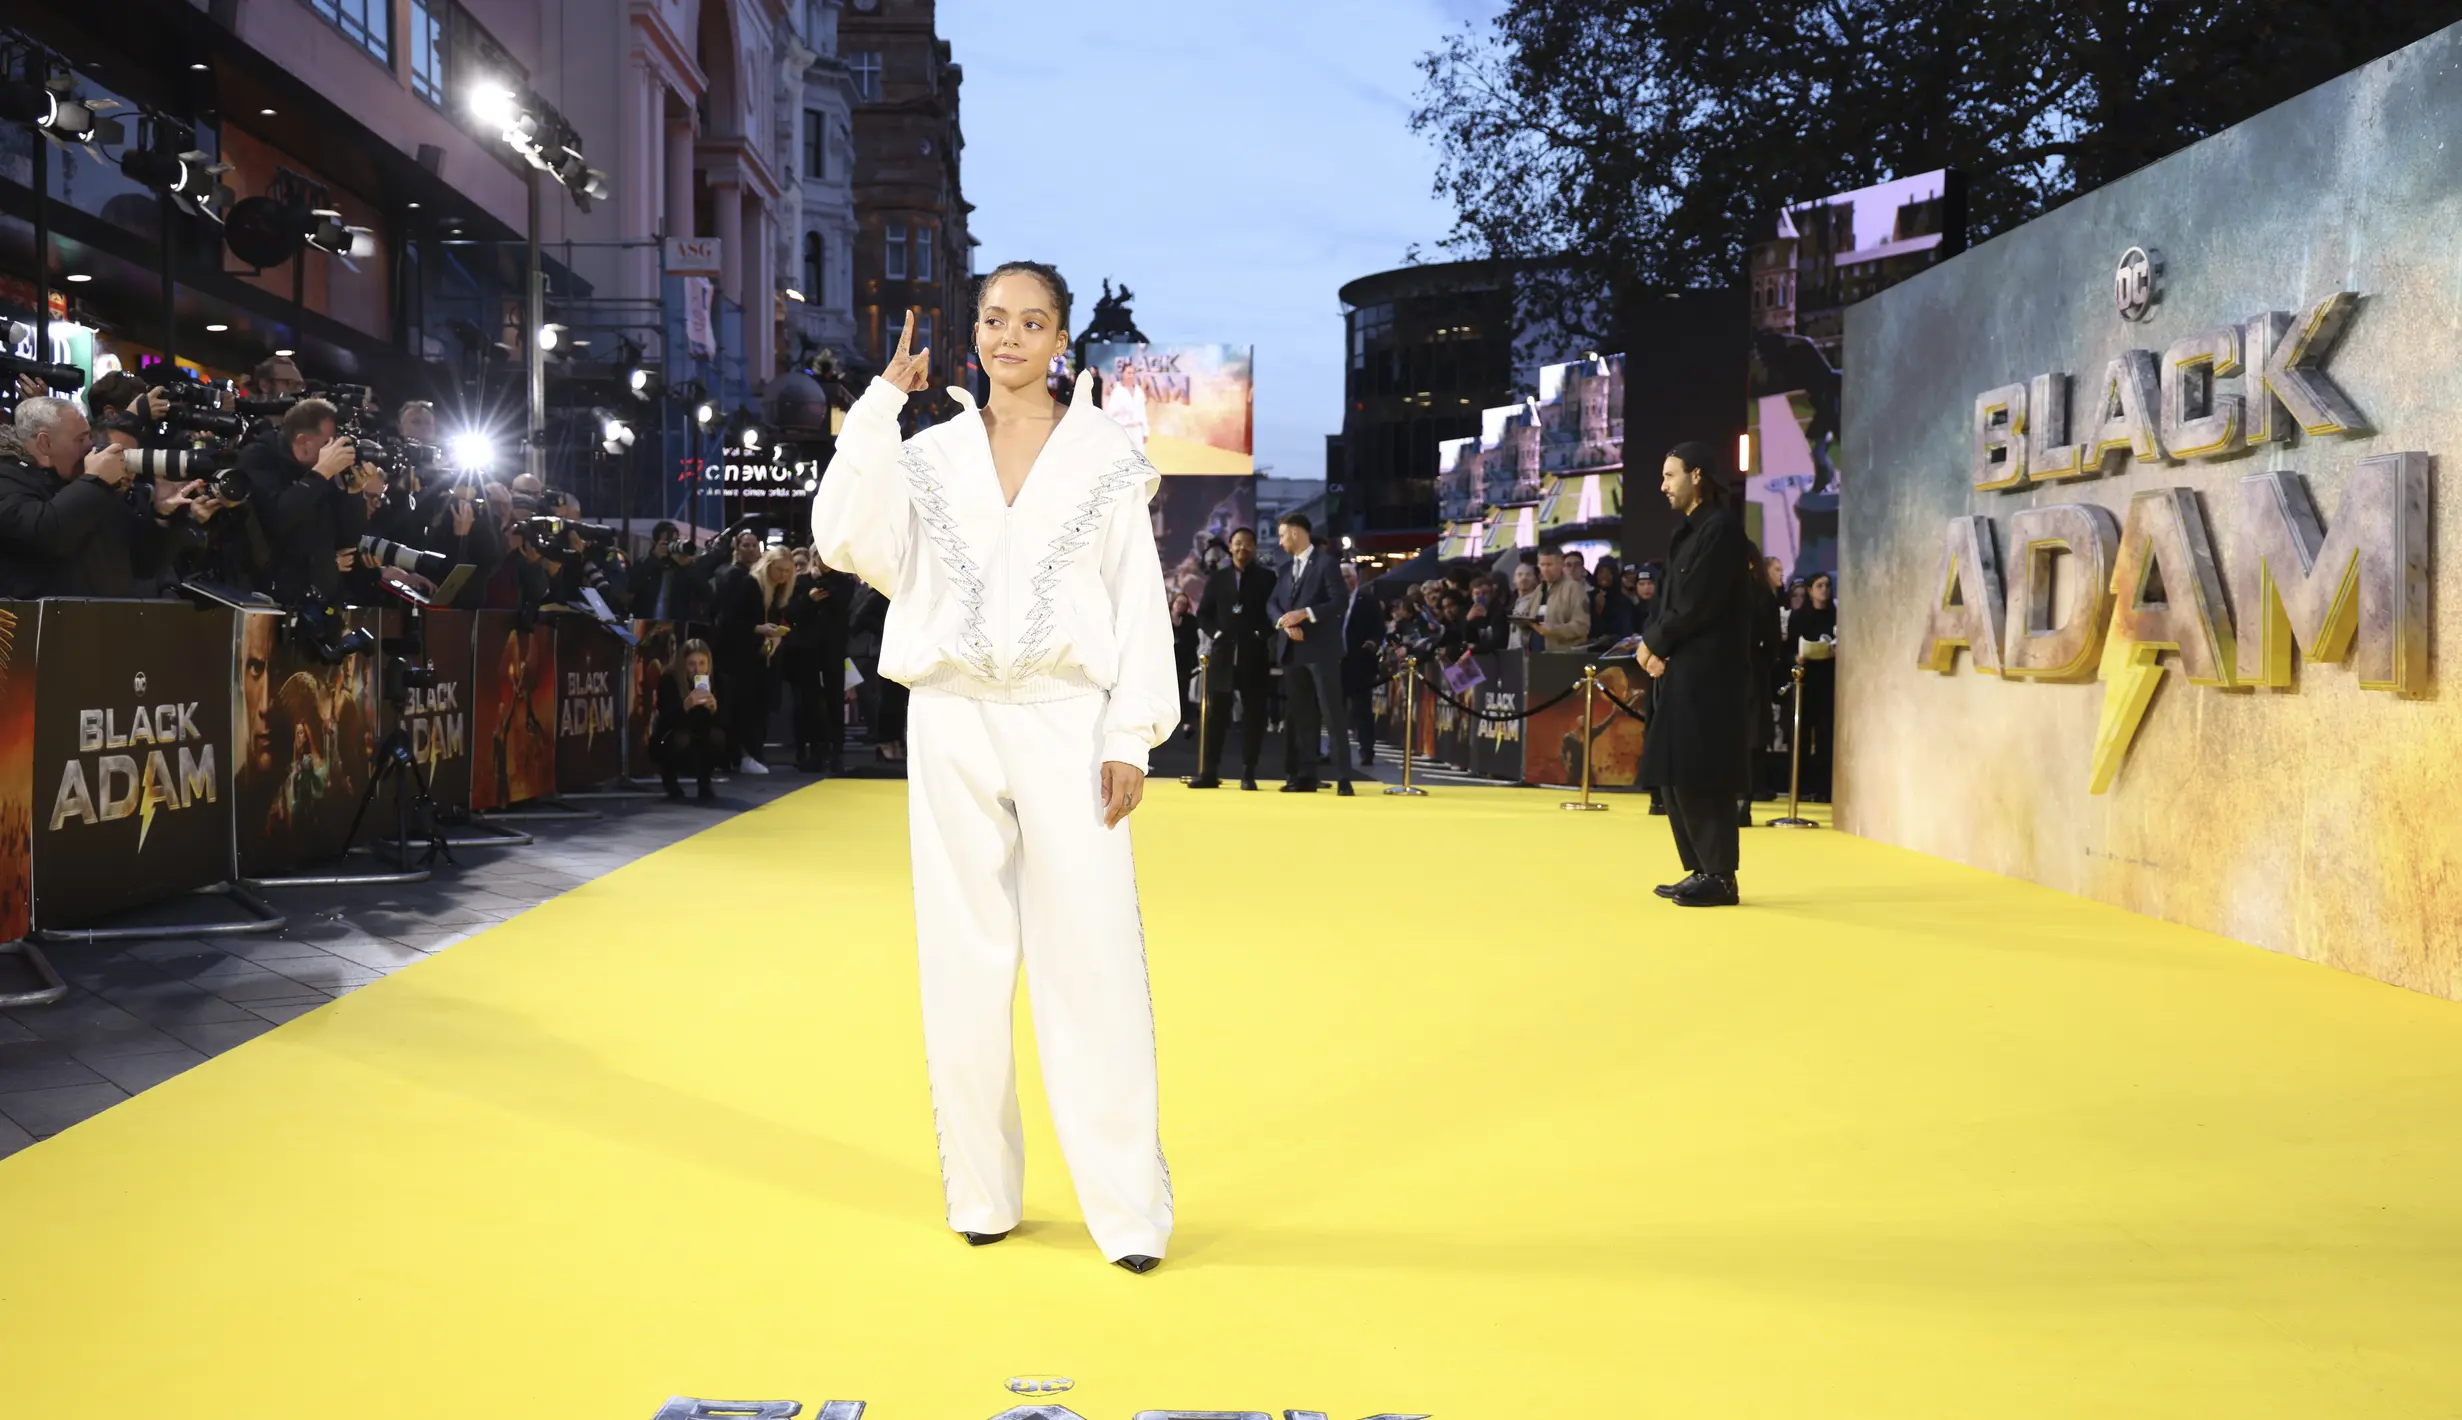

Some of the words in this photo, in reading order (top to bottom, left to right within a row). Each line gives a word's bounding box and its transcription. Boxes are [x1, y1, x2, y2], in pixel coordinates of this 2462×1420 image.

[678, 242, 711, 258] ASG
[2116, 252, 2150, 317] DC
[1974, 291, 2370, 492] BLACK
[1917, 451, 2428, 692] ADAM
[566, 671, 609, 696] BLACK
[79, 702, 201, 751] BLACK
[400, 713, 464, 765] DAM
[560, 697, 615, 738] ADAM
[49, 744, 216, 830] ADAM
[1003, 1375, 1075, 1397] DC
